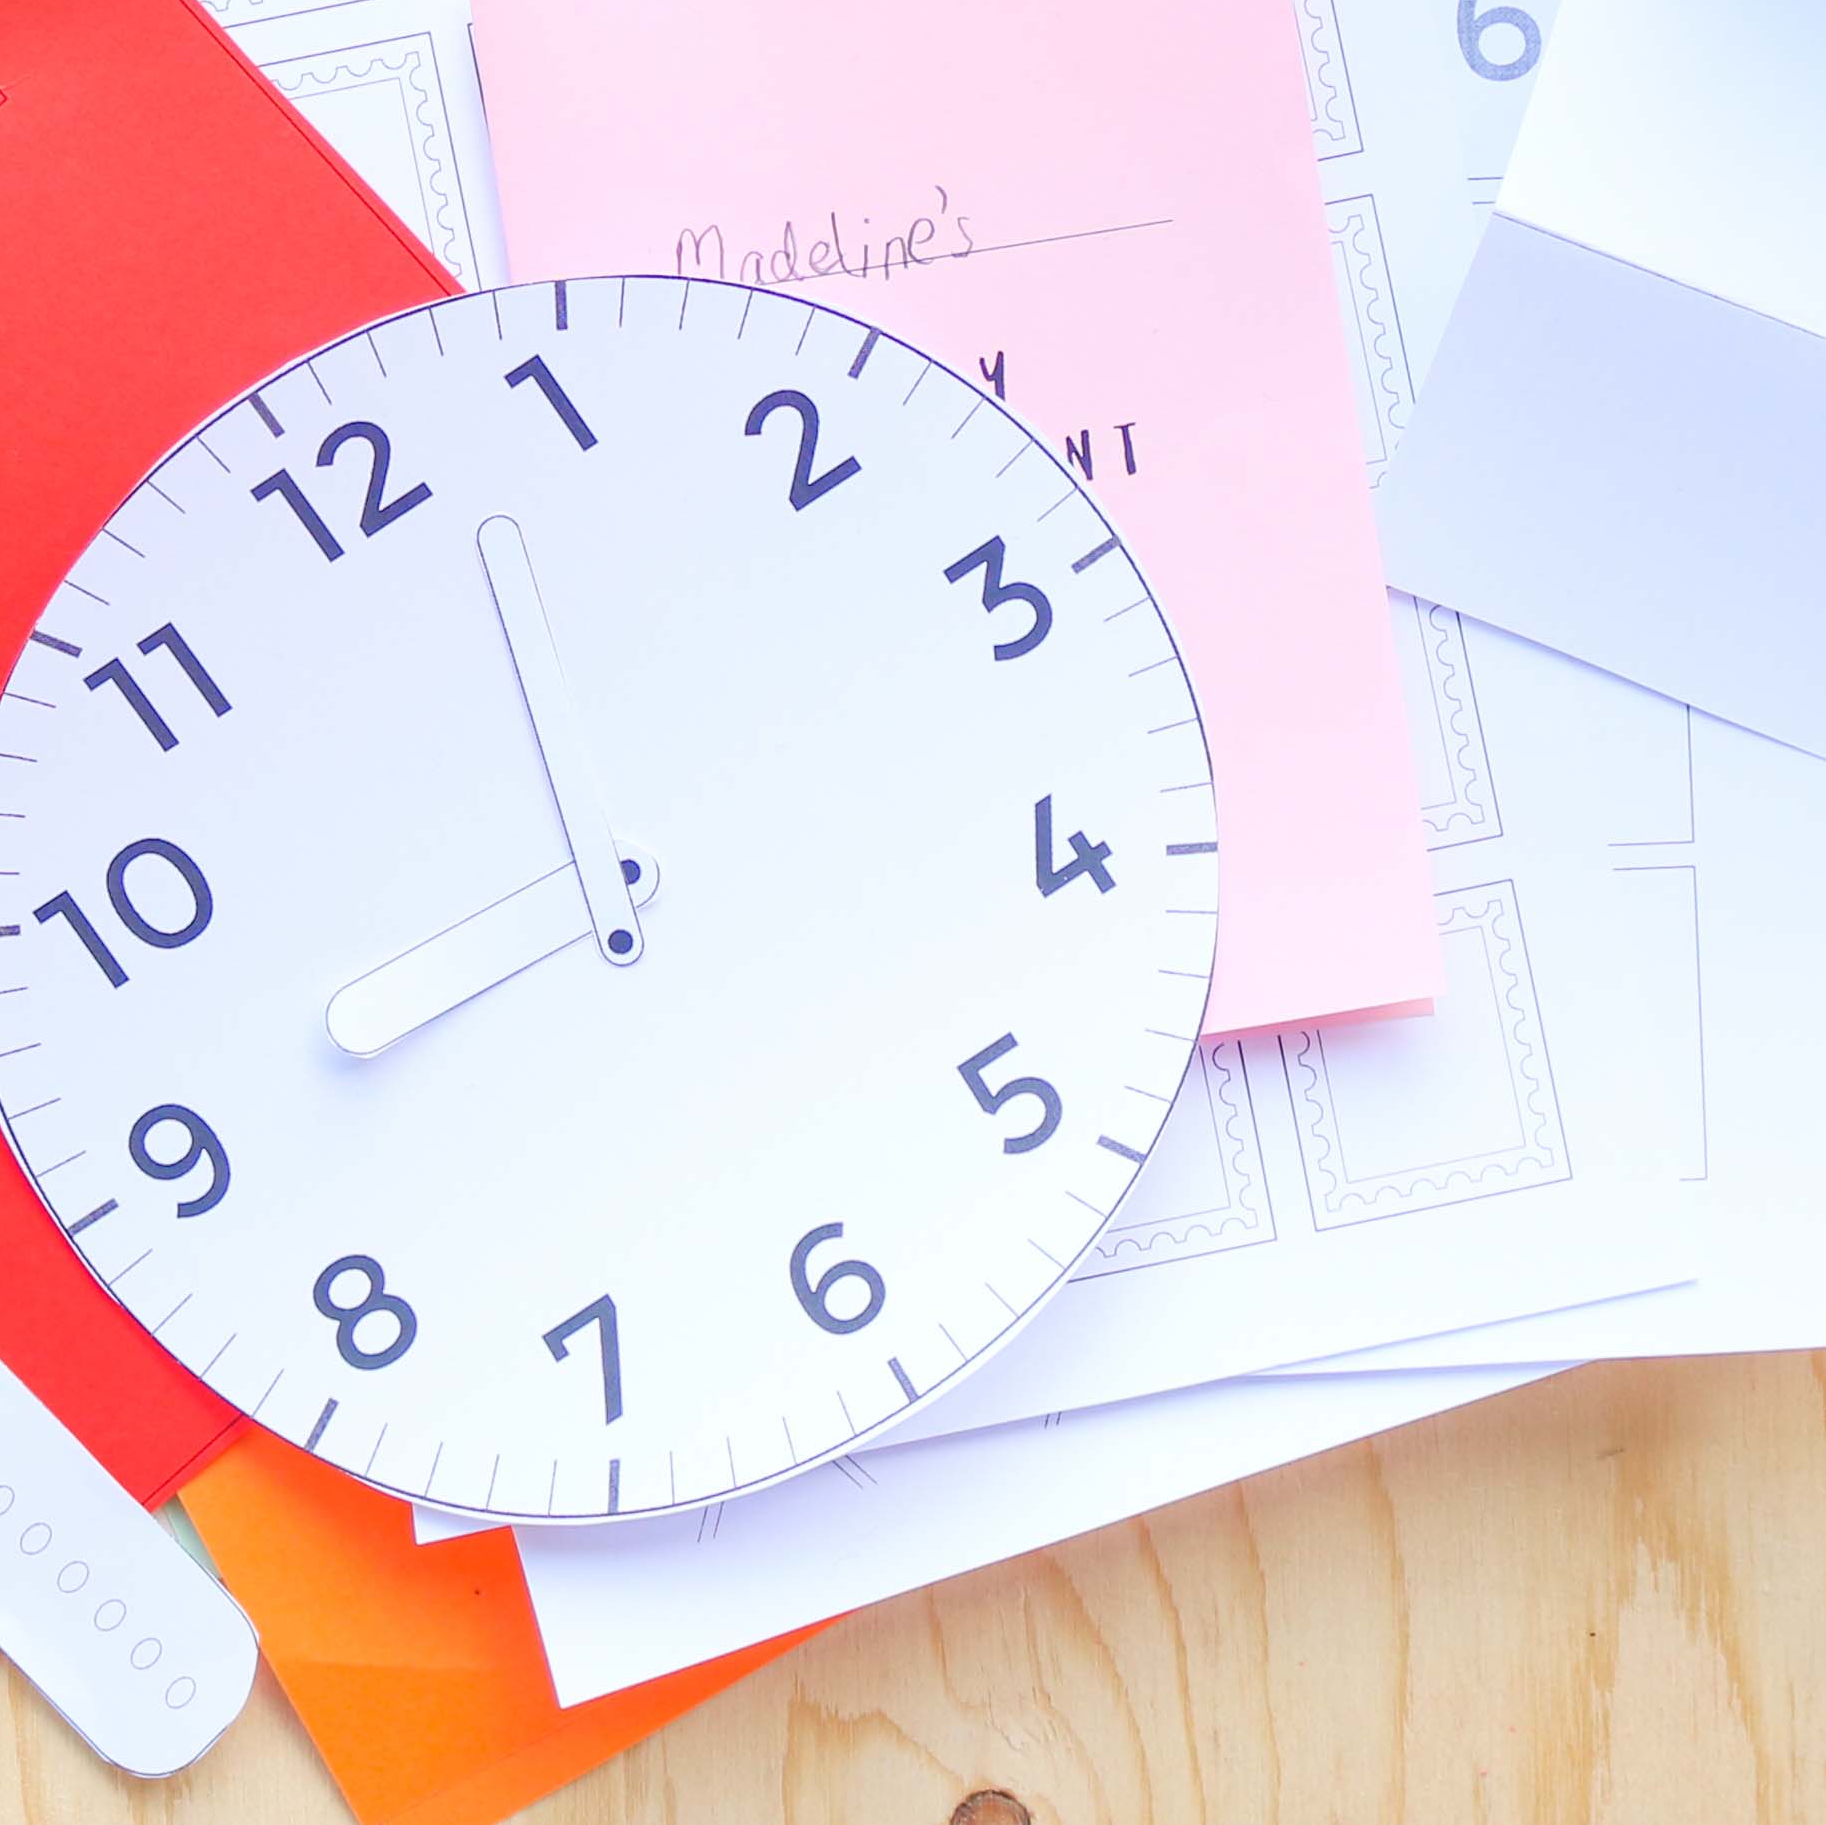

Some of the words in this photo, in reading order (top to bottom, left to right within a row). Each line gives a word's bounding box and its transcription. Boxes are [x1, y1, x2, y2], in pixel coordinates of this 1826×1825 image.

[675, 184, 974, 286] Madeline's
[503, 353, 599, 452] 1
[743, 389, 863, 513] 2
[249, 420, 434, 563] 12
[942, 534, 1053, 662] 3
[82, 621, 233, 753] 11
[1034, 793, 1117, 899] 4
[32, 837, 214, 989] 10
[956, 1031, 1063, 1155] 5
[128, 1103, 232, 1219] 9
[312, 1253, 418, 1372] 8
[789, 1221, 887, 1336] 6
[541, 1293, 624, 1426] 7
